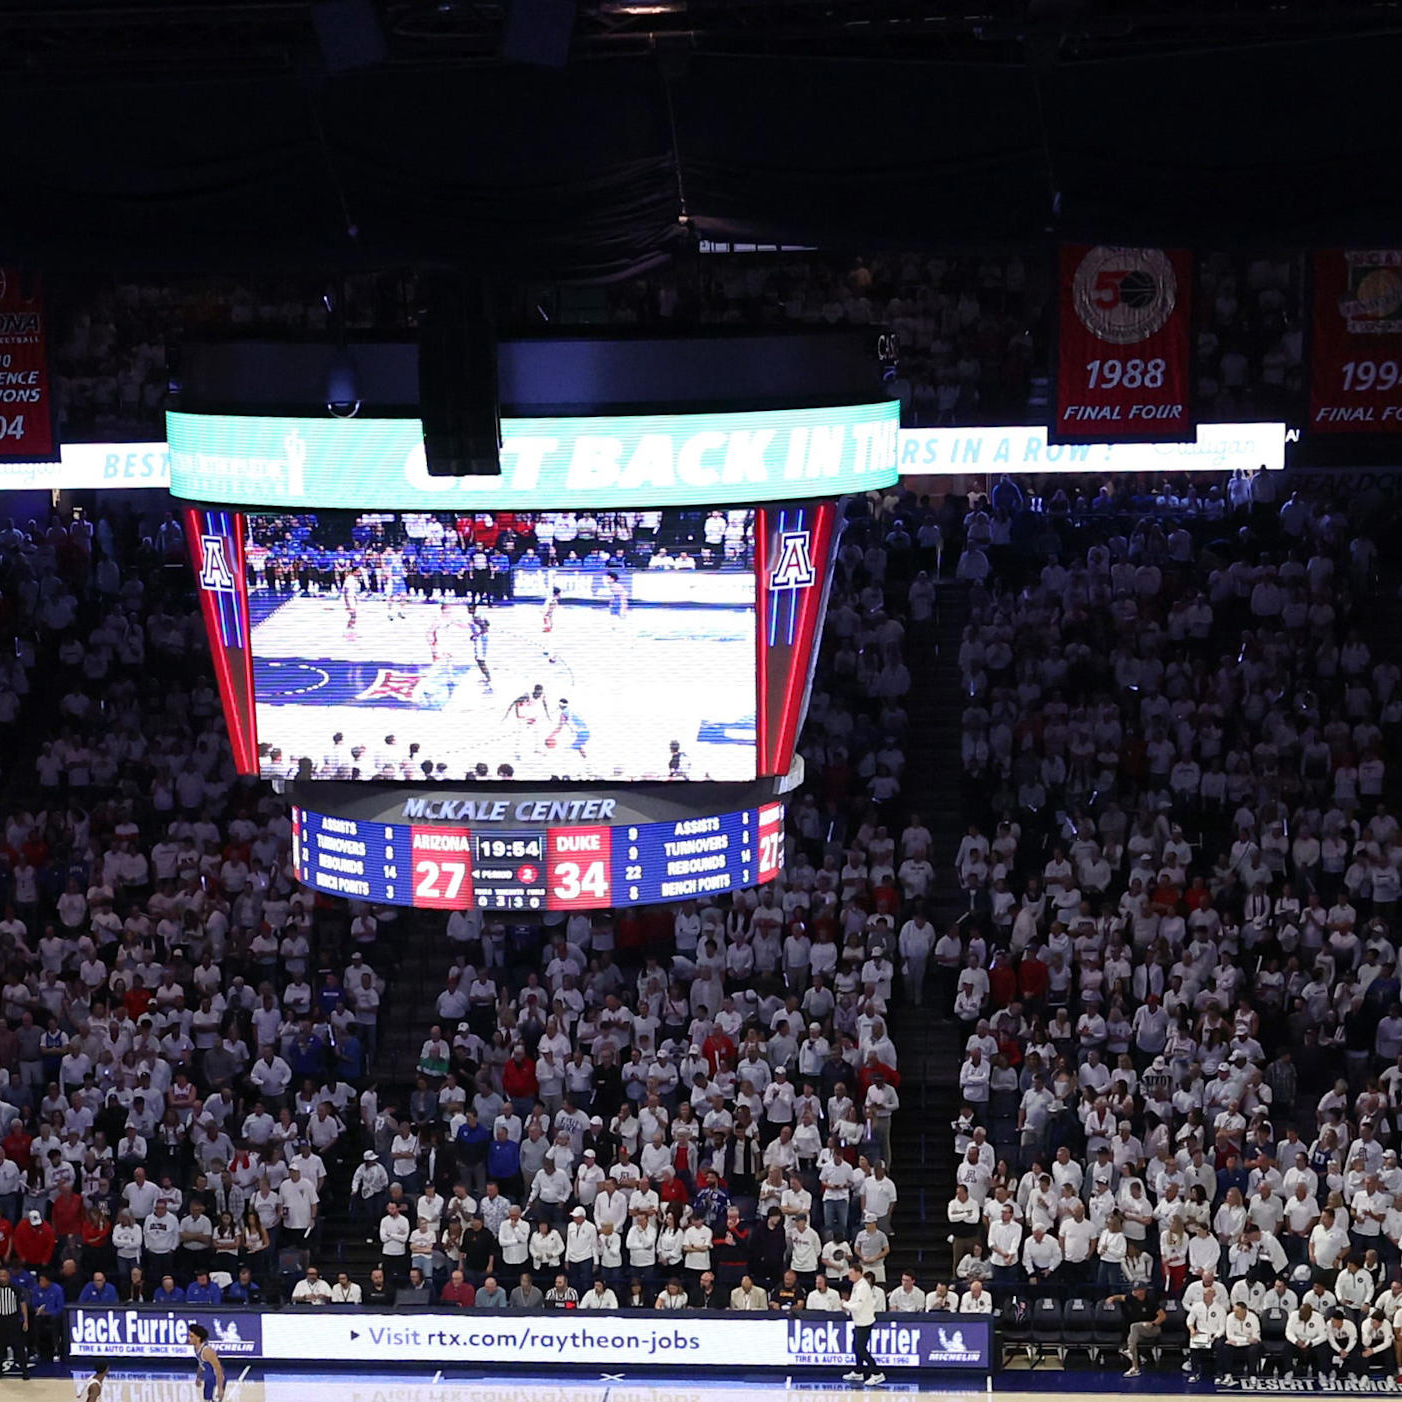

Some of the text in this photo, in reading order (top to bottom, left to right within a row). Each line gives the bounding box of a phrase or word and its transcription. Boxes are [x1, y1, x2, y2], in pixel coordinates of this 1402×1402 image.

[1086, 358, 1167, 390] 1988
[1063, 404, 1183, 421] FINAL FOUR
[1315, 406, 1375, 422] FINAL
[404, 436, 559, 492] GT
[566, 428, 778, 491] BACK
[784, 425, 846, 480] IN
[950, 435, 1012, 464] IN A
[514, 798, 617, 822] CENTER
[674, 817, 721, 836] ASSISTS
[316, 834, 366, 857] TURNOVERS
[413, 834, 471, 852] ARIZONA
[480, 840, 540, 858] 19:54
[556, 834, 601, 852] DUKE
[628, 846, 639, 860] 9
[663, 835, 729, 857] TURNOVERS
[759, 831, 779, 873] 27
[383, 865, 397, 880] 14
[523, 868, 533, 880] 2
[625, 849, 751, 880] 22 REBOUNDS 14
[339, 877, 370, 896] POINTS
[386, 885, 395, 899] 3
[415, 860, 467, 899] 27
[553, 861, 609, 900] 34
[698, 873, 731, 892] POINTS
[742, 869, 750, 883] 3
[514, 897, 524, 908] 3
[72, 1310, 197, 1344] Jack Furrie
[788, 1318, 839, 1354] Jack
[79, 1345, 96, 1354] TIRE
[105, 1345, 125, 1354] AUTO
[127, 1346, 145, 1354] CARE
[369, 1327, 701, 1354] Visit rtx.com/raytheon-jobs
[795, 1355, 812, 1363] TIRE
[814, 1355, 820, 1363] &
[928, 1352, 981, 1362] MICHELIN
